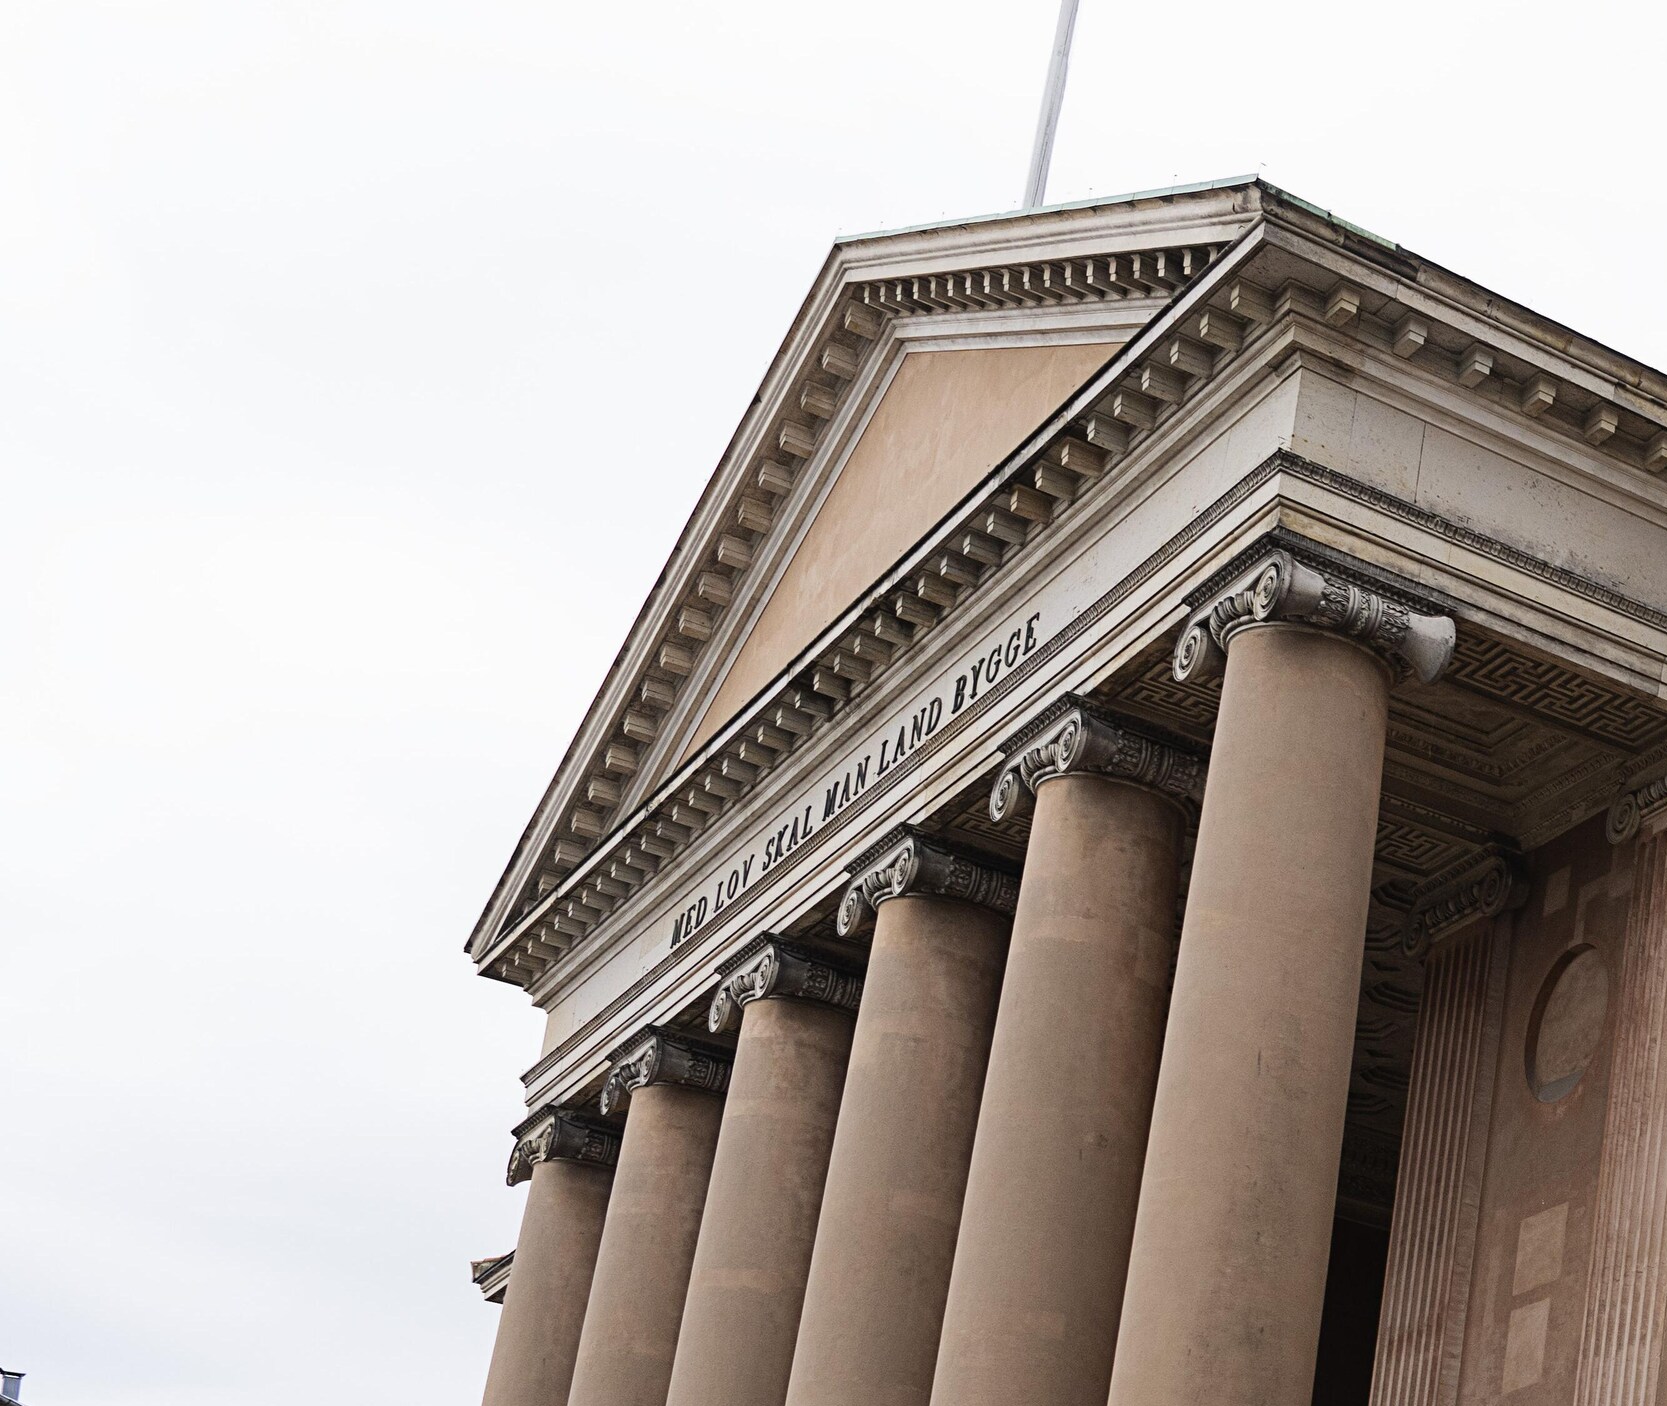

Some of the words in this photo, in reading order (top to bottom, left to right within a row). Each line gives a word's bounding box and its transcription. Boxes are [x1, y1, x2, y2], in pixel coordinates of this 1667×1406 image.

[670, 896, 708, 949] MED
[713, 854, 755, 913] LOV
[762, 805, 813, 871] SKAL
[822, 755, 871, 822] MAN
[877, 697, 942, 776] LAND
[951, 612, 1040, 714] BYGGE
